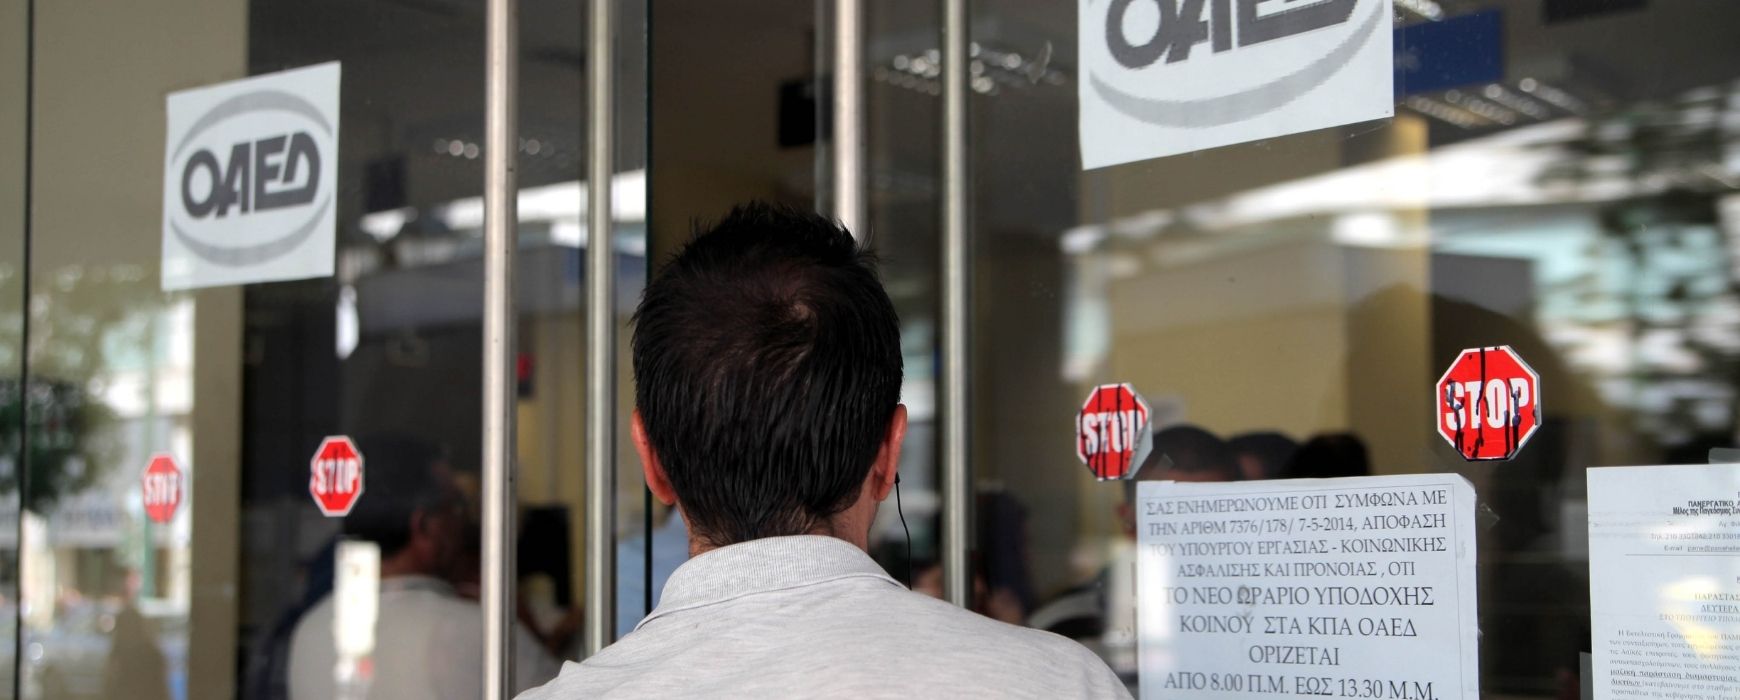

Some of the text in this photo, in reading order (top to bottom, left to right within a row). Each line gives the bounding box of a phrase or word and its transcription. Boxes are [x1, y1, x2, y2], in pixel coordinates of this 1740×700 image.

[1105, 0, 1360, 69] OA
[1445, 377, 1530, 431] STOP
[317, 457, 358, 495] STOP
[1146, 490, 1447, 515] ΣΑΣ ΕΝΗΜΕΡΩΝΟΥΜΕ ΟΤΙ ΣΥΜΦΩΝΑ ΜΕ
[1149, 521, 1177, 536] ΤΗΝ
[1181, 520, 1226, 535] ΑΡΙΘΜ
[1299, 517, 1358, 532] 7-5-2014,
[1362, 513, 1446, 529] ΑΠΟΦΑΣΗ
[1150, 543, 1176, 557] ΤΟΥ
[1178, 541, 1254, 556] ΥΠΟΥΡΓΟΥ
[1257, 540, 1328, 555] ΕΡΓΑΣΙΑΣ
[1341, 536, 1447, 554] ΚΟΙΝΩΝΙΚΗΣ
[1177, 563, 1260, 578] ΑΣΦΑΛΙΣΗΣ
[1264, 562, 1290, 577] ΚΑΙ
[1294, 561, 1377, 577] ΠΡΟΝΟΙΑΣ
[1388, 560, 1416, 576] ΟΤΙ
[1164, 586, 1434, 606] ΤΟ ΝΕΟ ΩΡΑΡΙΟ ΥΠΟΔΟΧΗΣ
[1180, 615, 1418, 637] ΚΟΙΝΟΥ ΣΤΑ ΚΠΑ ΟΑΕΔ
[1248, 645, 1340, 666] ΟΡΙΖΕΤΑΙ
[1164, 671, 1440, 700] ΑΠΟ 8.00 Π.Μ. ΕΩΣ 13.30 Μ.Μ.
